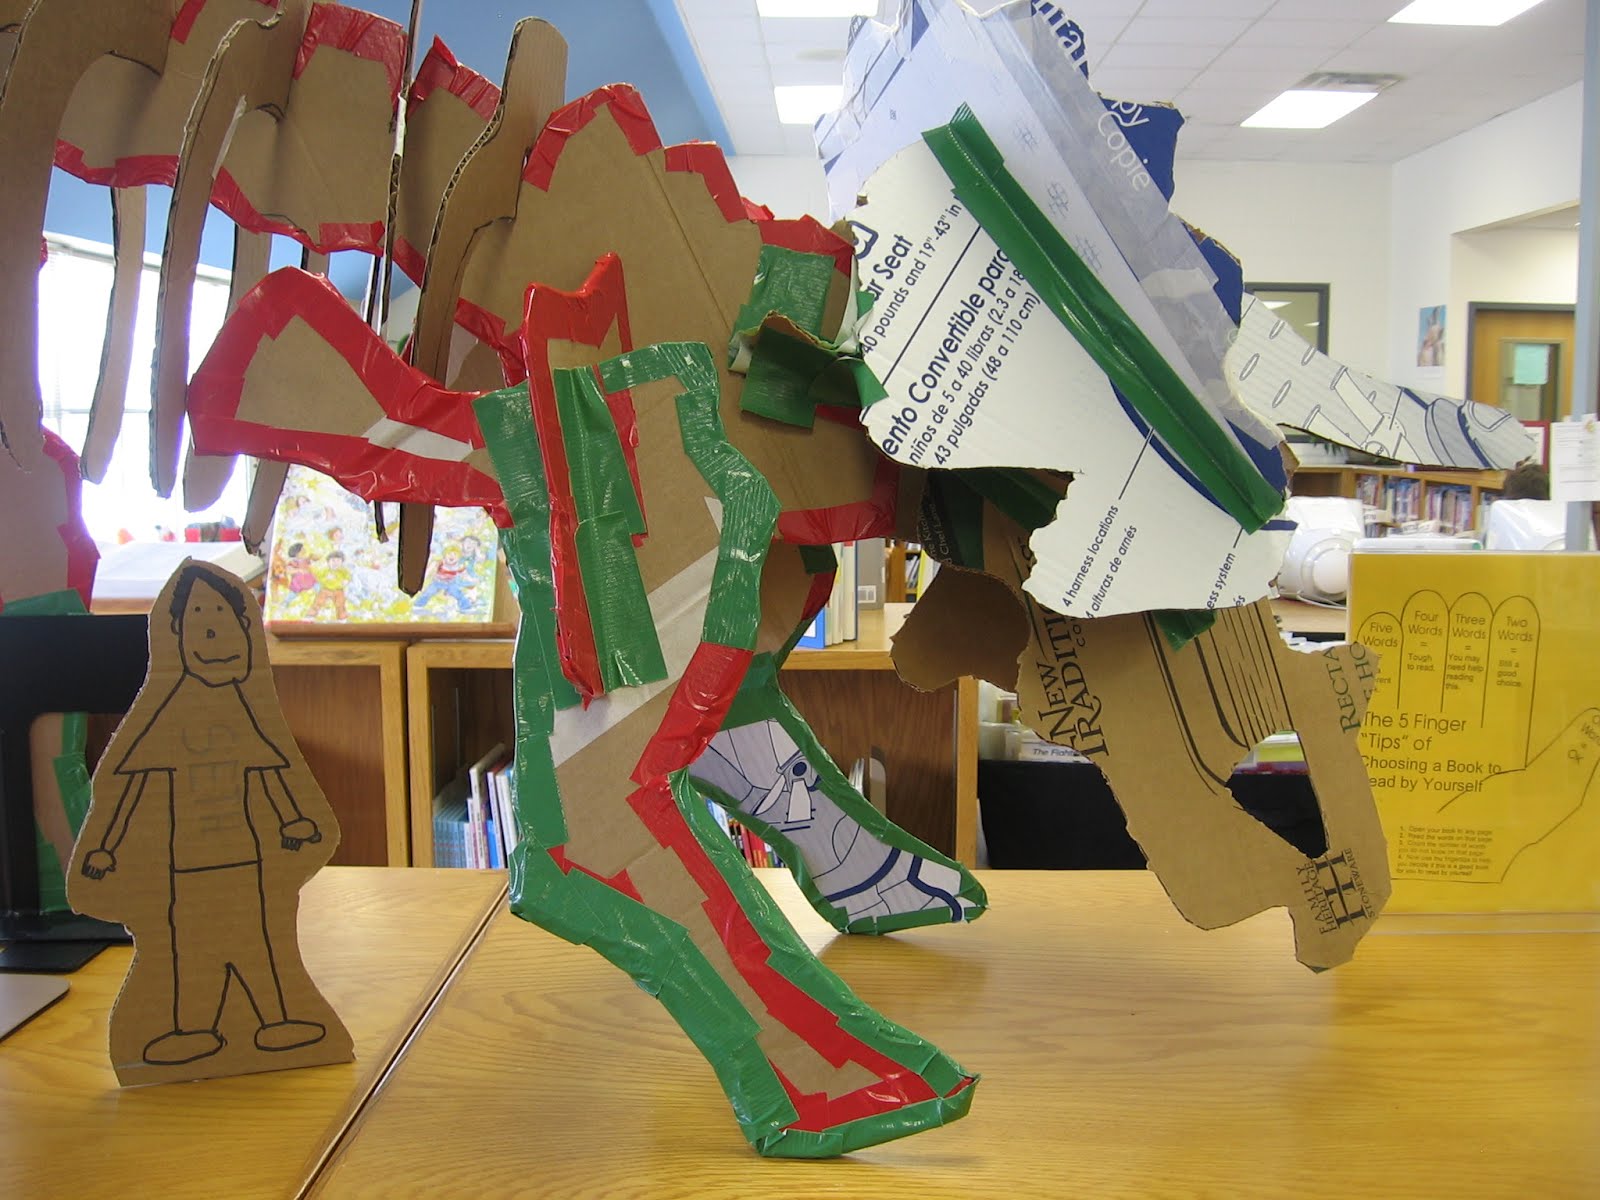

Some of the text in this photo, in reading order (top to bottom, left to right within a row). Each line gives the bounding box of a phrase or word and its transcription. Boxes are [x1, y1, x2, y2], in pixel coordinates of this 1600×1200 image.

[1098, 111, 1150, 192] Copie
[873, 234, 913, 280] Seat
[873, 288, 909, 338] pounds
[905, 258, 928, 287] and
[1005, 287, 1017, 299] a
[965, 323, 995, 363] libras
[882, 405, 918, 456] ento
[908, 292, 986, 404] Convertible
[957, 356, 974, 379] 40
[933, 291, 1041, 466] 43 pulgadas (48 a 110 cm)
[951, 380, 963, 392] a
[942, 390, 956, 404] 5
[932, 401, 950, 424] de
[909, 427, 937, 464] niños
[1063, 504, 1119, 608] 4 harness locations
[1091, 575, 1114, 612] alturas
[1109, 555, 1123, 573] de
[1117, 524, 1138, 556] arnés
[1214, 552, 1236, 592] system
[1414, 610, 1439, 622] Four
[1455, 613, 1486, 626] Three
[1506, 616, 1528, 628] Two
[1370, 622, 1393, 633] Five
[1408, 624, 1443, 637] Words
[1452, 627, 1487, 640] Words
[1498, 630, 1533, 642] Words
[1363, 635, 1398, 648] Words
[1408, 653, 1433, 663] Tough
[1448, 653, 1480, 664] You may
[1467, 664, 1484, 672] help
[1497, 670, 1517, 678] good
[1040, 607, 1110, 757] TRADITI
[1446, 674, 1474, 683] reading
[1036, 661, 1078, 741] NEW
[1399, 713, 1409, 728] 5
[1414, 713, 1467, 734] Finger
[1413, 735, 1433, 751] of
[1432, 761, 1442, 771] a
[1446, 759, 1483, 774] Book
[1488, 762, 1502, 775] to
[1368, 775, 1484, 793] ead by Yourself
[1343, 847, 1376, 919] STONEWARE
[1296, 866, 1327, 935] FAMILY
[1304, 860, 1338, 933] HERITAGE
